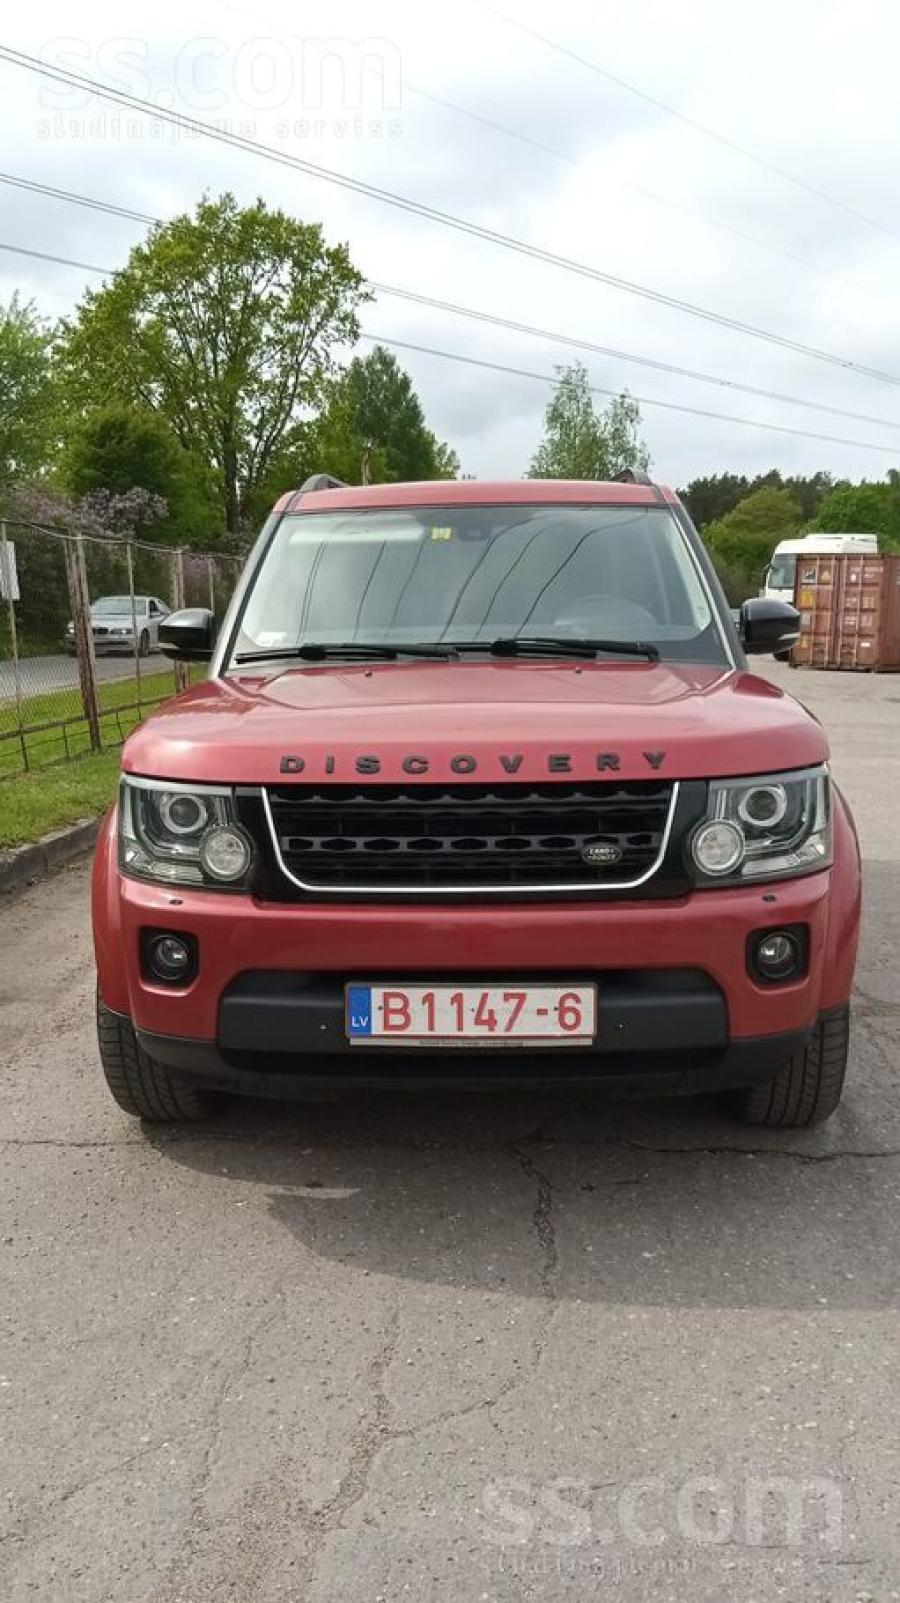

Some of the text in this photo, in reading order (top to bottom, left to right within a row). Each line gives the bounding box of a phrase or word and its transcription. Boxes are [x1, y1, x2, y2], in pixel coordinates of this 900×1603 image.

[279, 751, 667, 775] DISCOVERY
[351, 1015, 369, 1028] LV
[382, 991, 582, 1032] B1147-6
